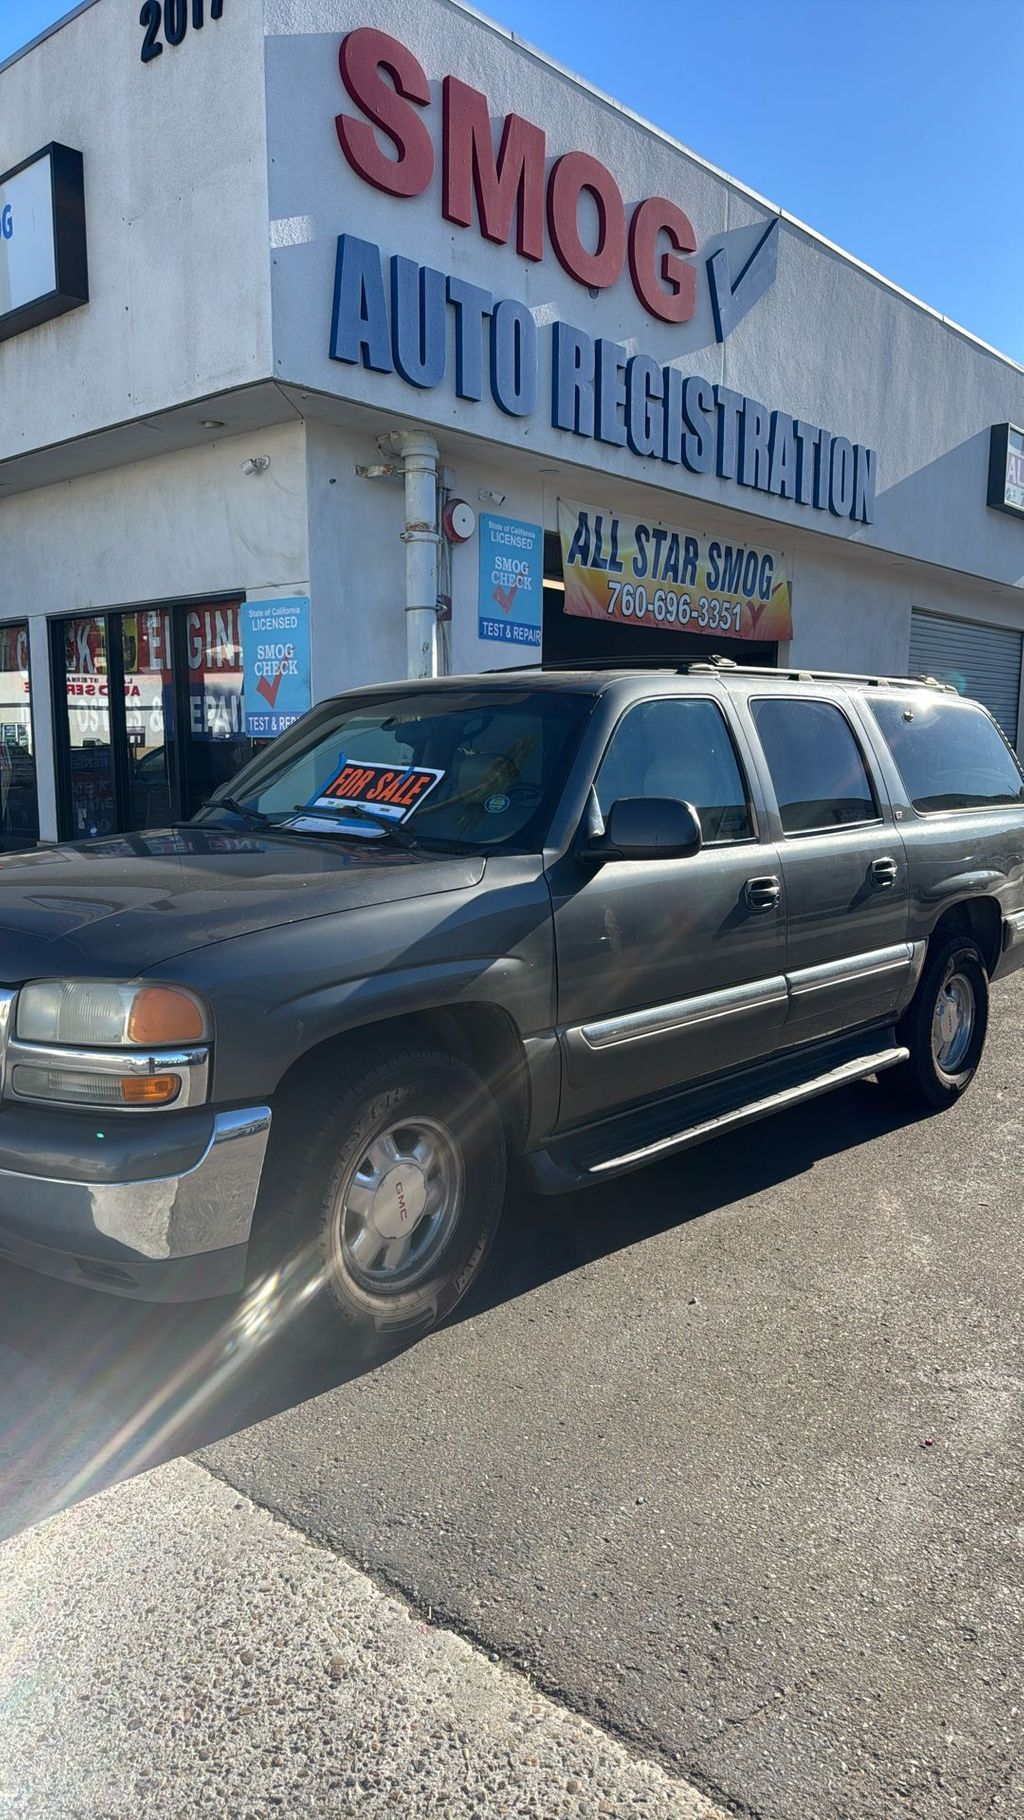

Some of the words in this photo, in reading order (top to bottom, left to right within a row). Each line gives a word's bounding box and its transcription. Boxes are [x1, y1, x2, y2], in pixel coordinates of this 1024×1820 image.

[335, 27, 697, 323] SMOG
[0, 204, 14, 240] G
[329, 233, 538, 417] AUTO
[552, 321, 877, 524] REGISTRATION
[490, 530, 533, 550] LICENSED
[495, 556, 529, 575] SMOG
[567, 511, 624, 574] ALL
[632, 524, 699, 587] STAR
[706, 541, 774, 601] SMOG
[491, 570, 533, 590] CHECK
[607, 581, 741, 631] 760-696-3351
[252, 616, 298, 631] LICENSED
[483, 621, 504, 637] TEST
[505, 625, 511, 638] &
[513, 627, 541, 643] REPAIR
[257, 643, 294, 659] SMOG
[254, 660, 299, 676] CHECK
[248, 716, 269, 731] TEST
[271, 716, 277, 731] &
[324, 767, 376, 797] FOR
[366, 772, 431, 805] SALE
[395, 1182, 408, 1222] GMC
